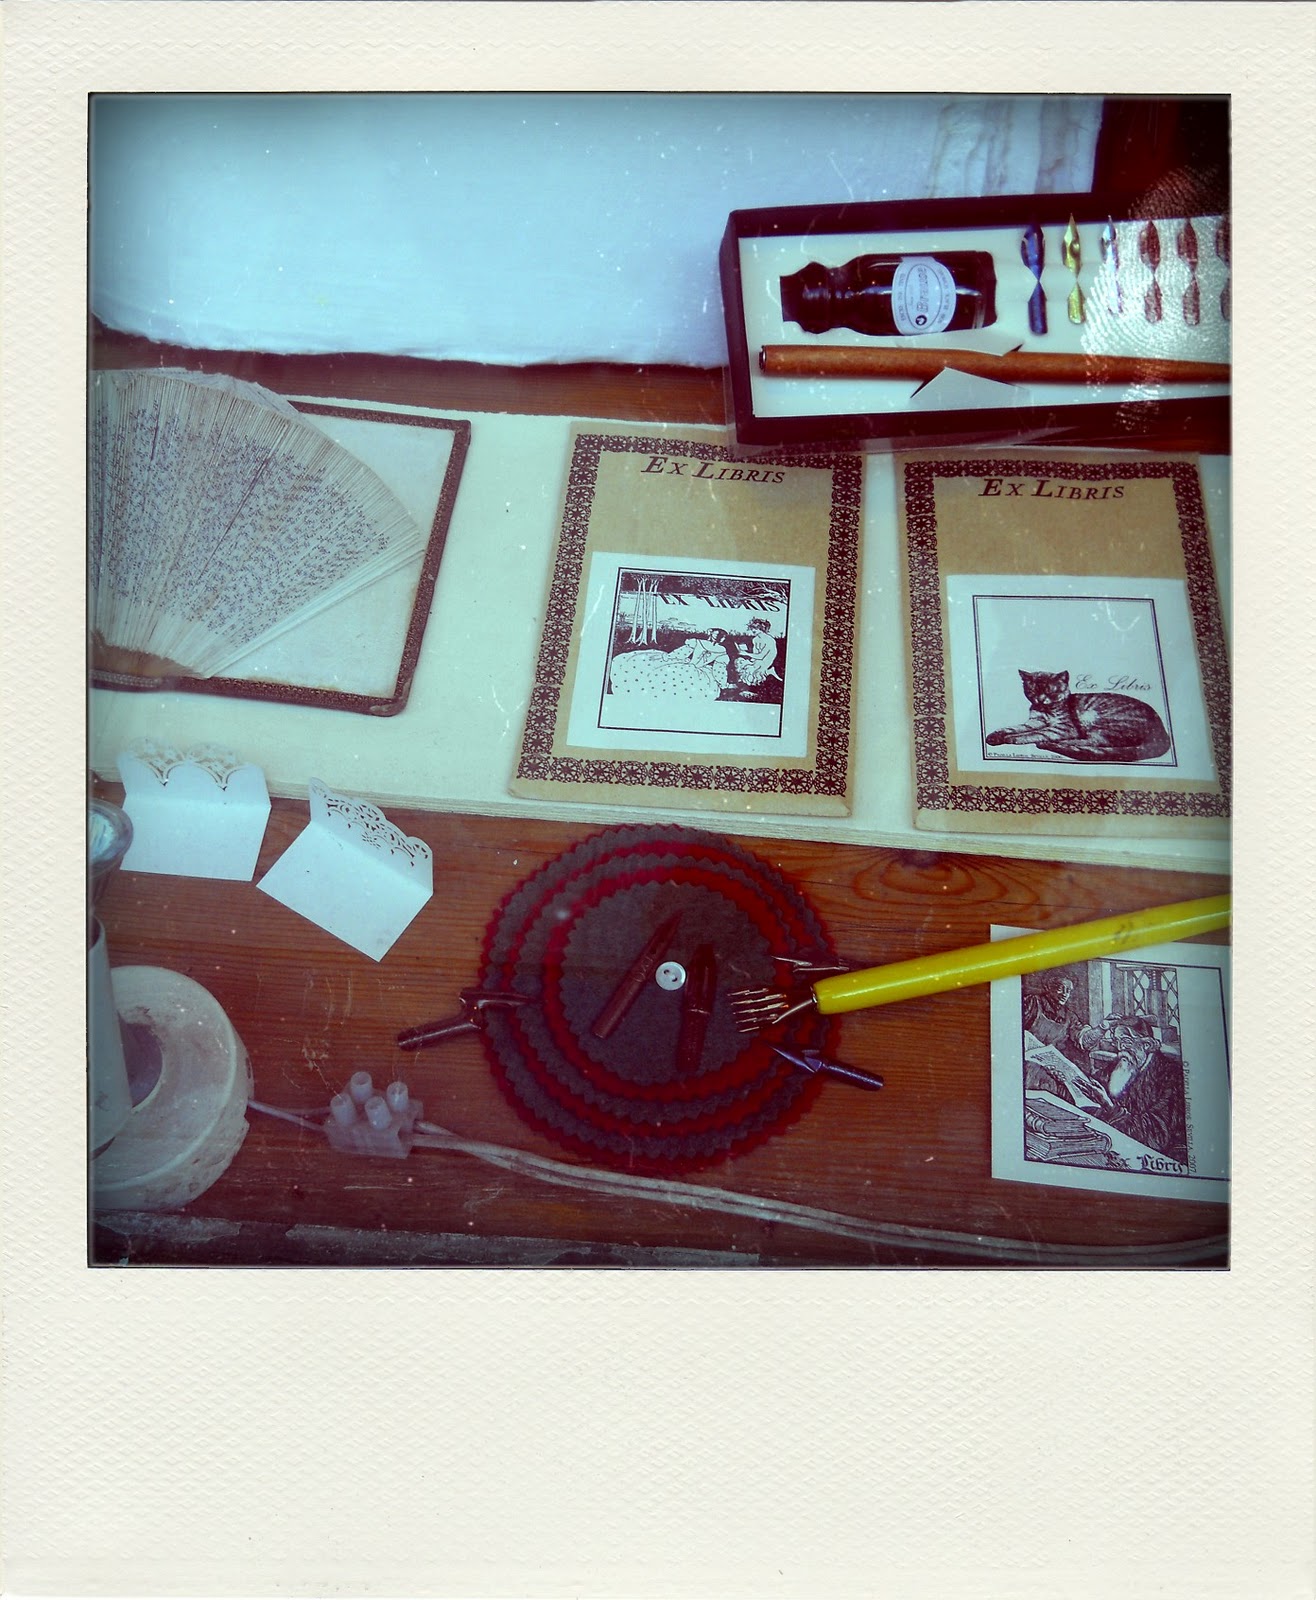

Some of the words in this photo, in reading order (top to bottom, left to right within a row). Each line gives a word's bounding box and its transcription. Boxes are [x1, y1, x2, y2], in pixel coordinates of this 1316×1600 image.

[640, 455, 688, 475] EX
[692, 461, 786, 484] LIBRIS
[978, 478, 1025, 496] EX
[1031, 479, 1125, 500] LIBRIS
[1075, 674, 1098, 689] Ex
[1103, 674, 1151, 691] Libris
[1136, 1153, 1187, 1174] Libris
[1188, 1154, 1197, 1174] 2007
